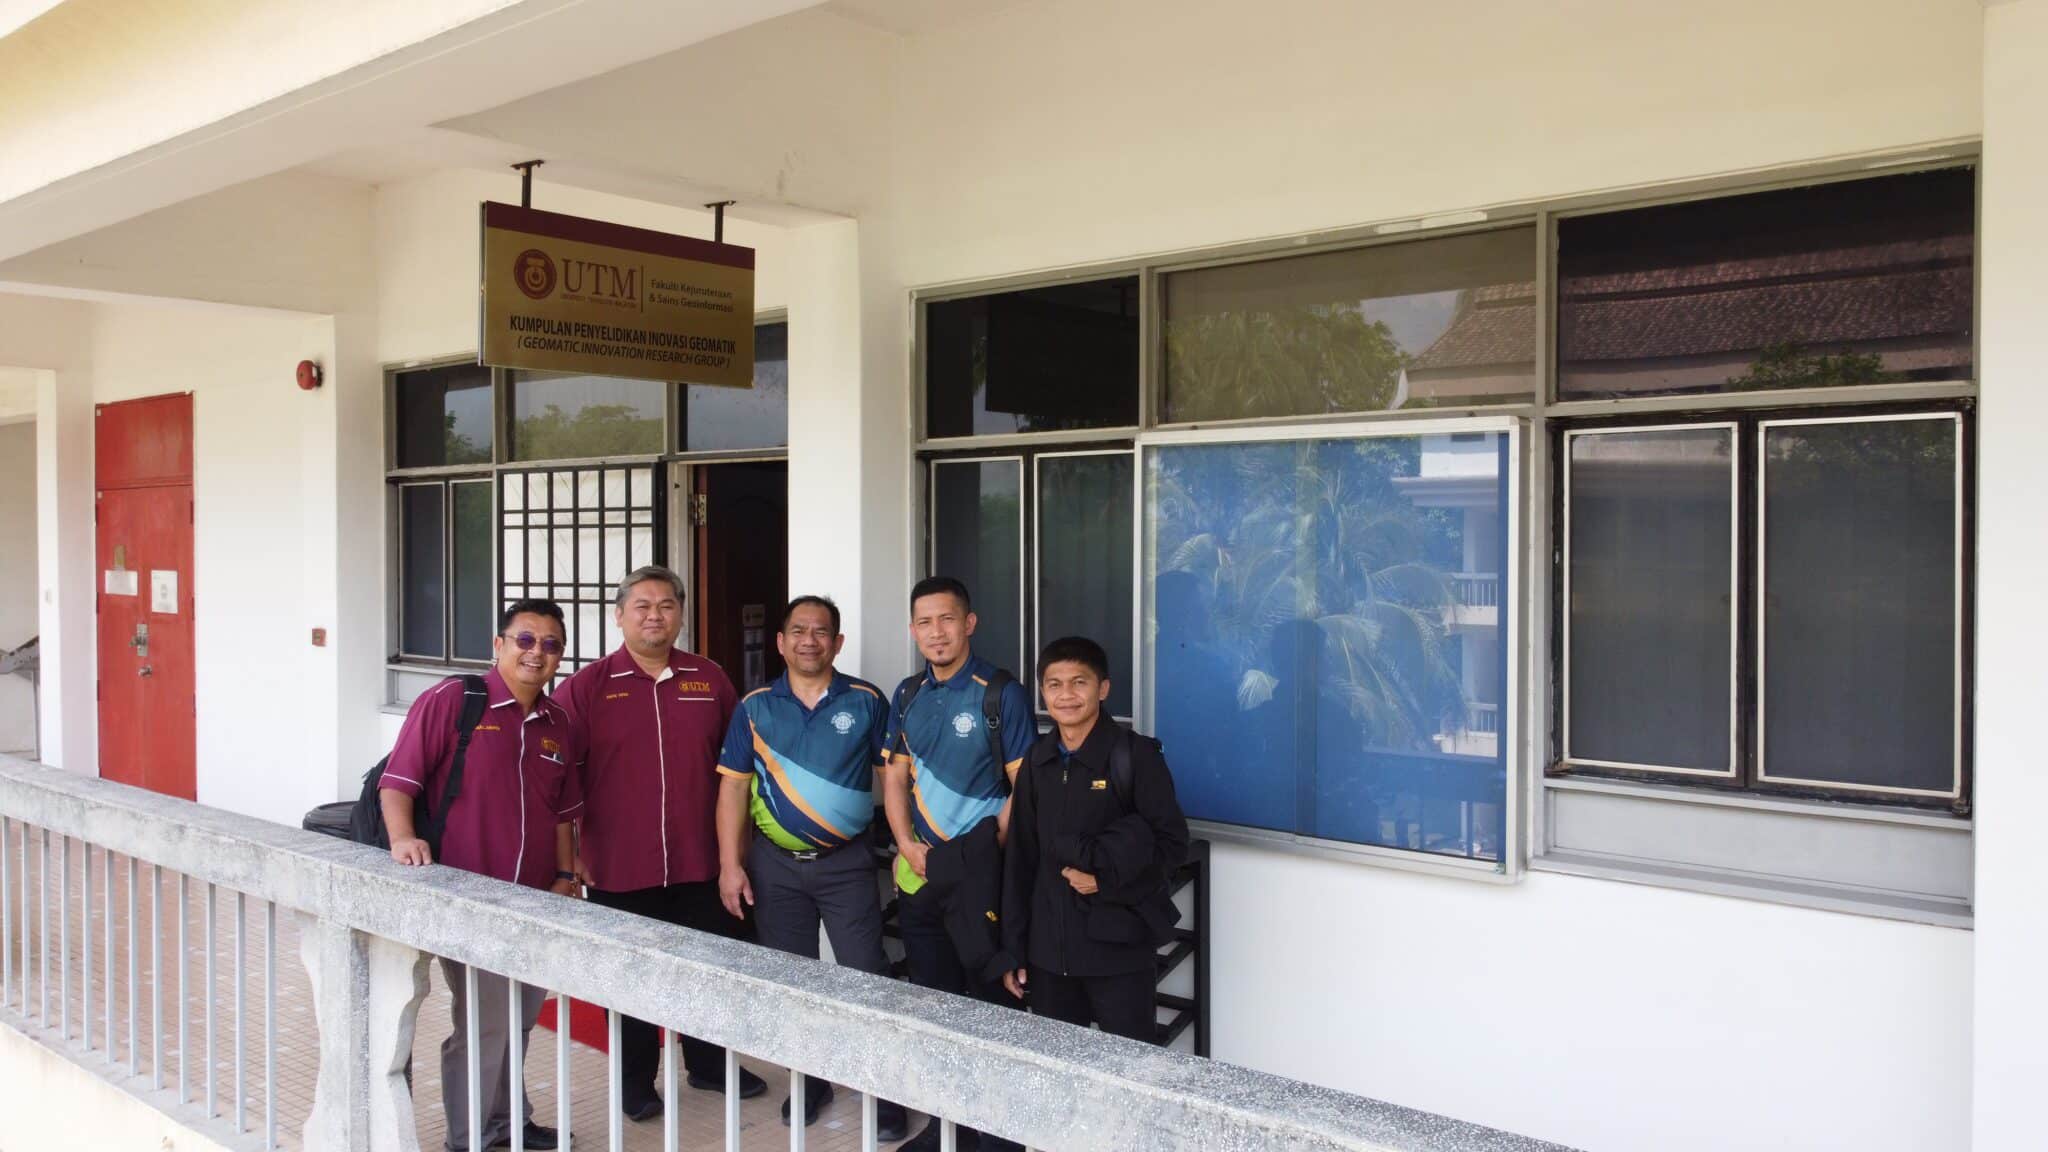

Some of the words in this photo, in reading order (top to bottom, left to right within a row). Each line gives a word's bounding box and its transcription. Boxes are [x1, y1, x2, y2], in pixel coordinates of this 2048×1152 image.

[561, 258, 637, 300] UTM
[651, 279, 679, 292] Fakulti
[510, 315, 572, 336] KUMPULAN
[574, 322, 647, 345] PENYELIDIKAN
[648, 331, 689, 349] INOVASI
[690, 336, 736, 354] GEOMATIK
[523, 336, 580, 353] GEOMATIC
[581, 342, 645, 360] INNOVATION
[645, 350, 693, 364] RESEARCH
[694, 354, 727, 368] GROUP
